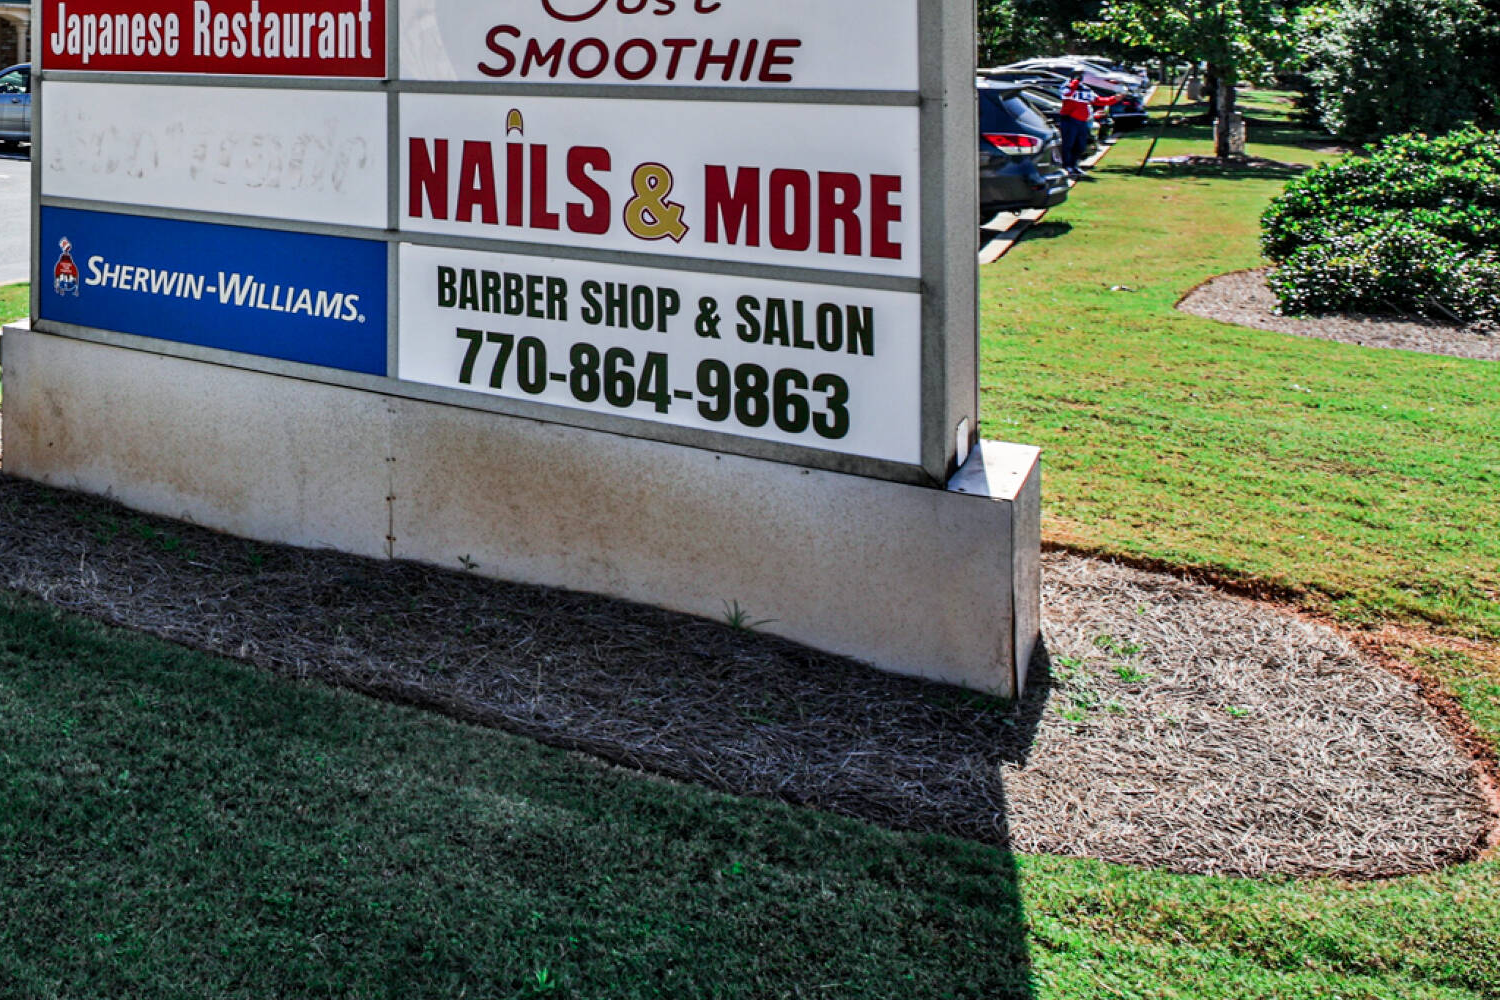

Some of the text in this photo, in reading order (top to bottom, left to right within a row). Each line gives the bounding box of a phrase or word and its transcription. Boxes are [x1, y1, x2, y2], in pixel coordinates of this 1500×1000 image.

[50, 1, 180, 64] Japanese
[477, 24, 802, 82] SMOOTHIE
[408, 108, 612, 235] NAILS
[623, 161, 690, 244] &
[704, 164, 902, 260] MORE
[437, 265, 875, 357] BARBER SHOP & SALON
[455, 327, 850, 440] 770-864-9863
